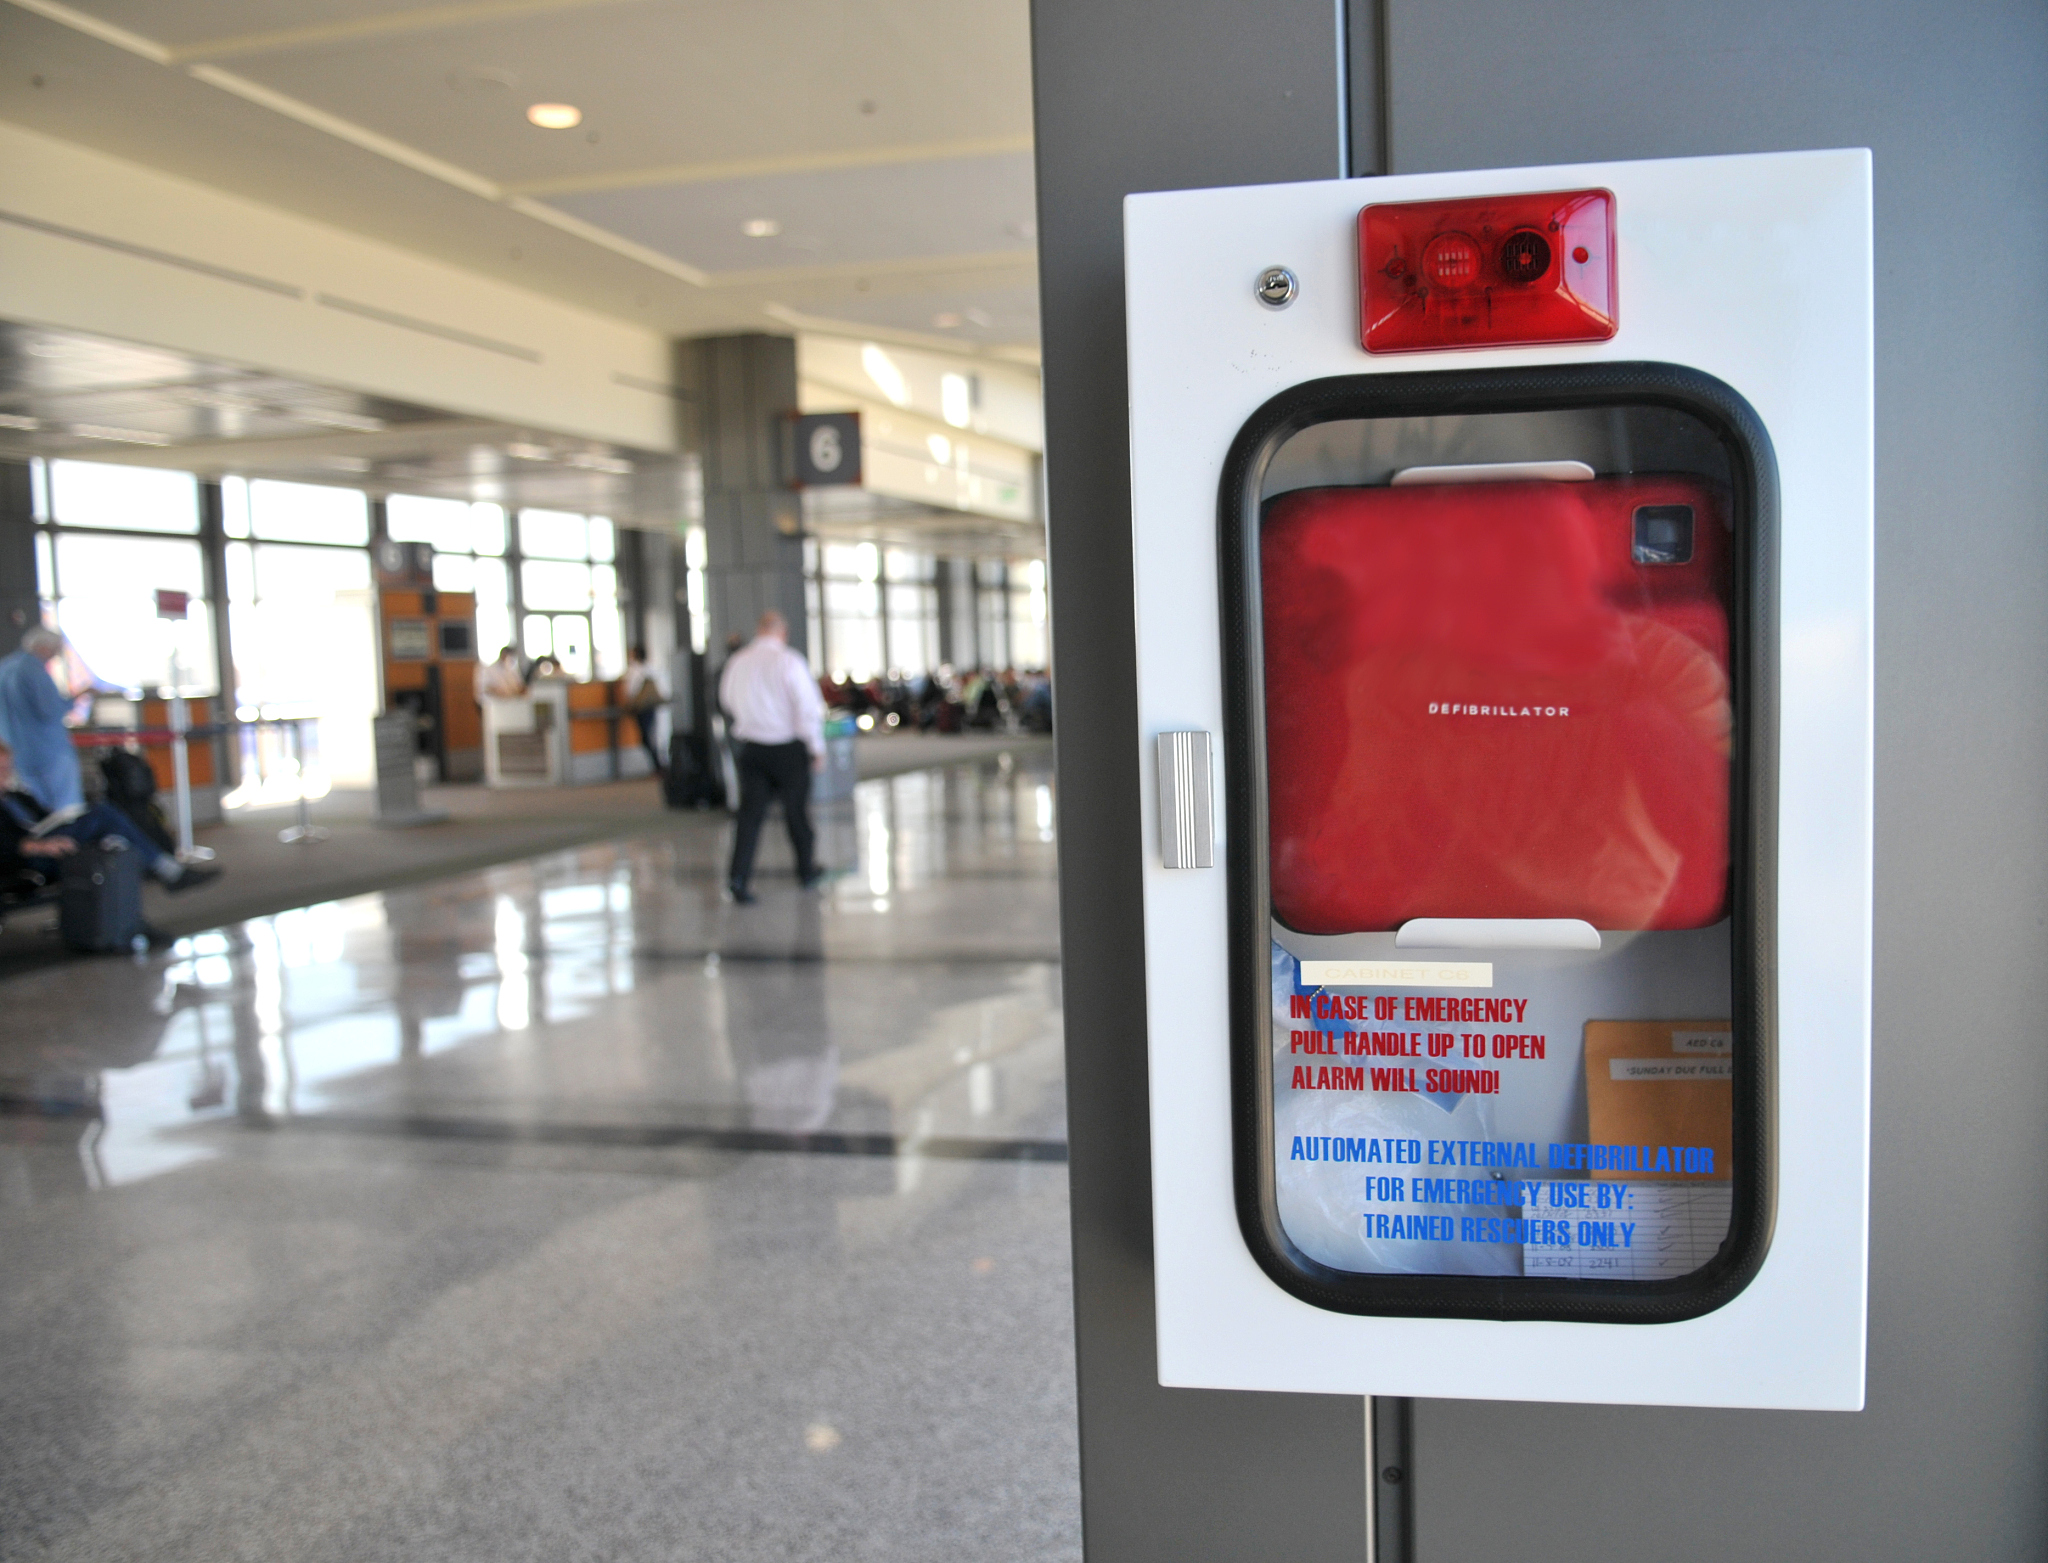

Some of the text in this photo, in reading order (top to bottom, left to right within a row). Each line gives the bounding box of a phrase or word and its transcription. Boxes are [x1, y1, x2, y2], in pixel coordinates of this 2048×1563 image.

[809, 424, 842, 473] 6
[1428, 702, 1569, 717] DEFIBRILLATOR
[1324, 968, 1470, 982] CABINET C6
[1290, 995, 1528, 1023] IN CASE OF EMERGENCY
[1290, 1030, 1546, 1060] PULL HANDLE UP TO OPEN
[1686, 1039, 1707, 1048] AED
[1291, 1066, 1500, 1095] ALARM WILL SOUND!
[1675, 1065, 1696, 1075] DUE
[1699, 1065, 1724, 1075] FULL
[1290, 1136, 1715, 1174] AUTOMATED EXTERNAL DEFIBRILLATOR
[1365, 1176, 1634, 1210] FOR EMERGENCY USE BY:
[1363, 1213, 1636, 1248] TRAINED RESCUERS ONLY
